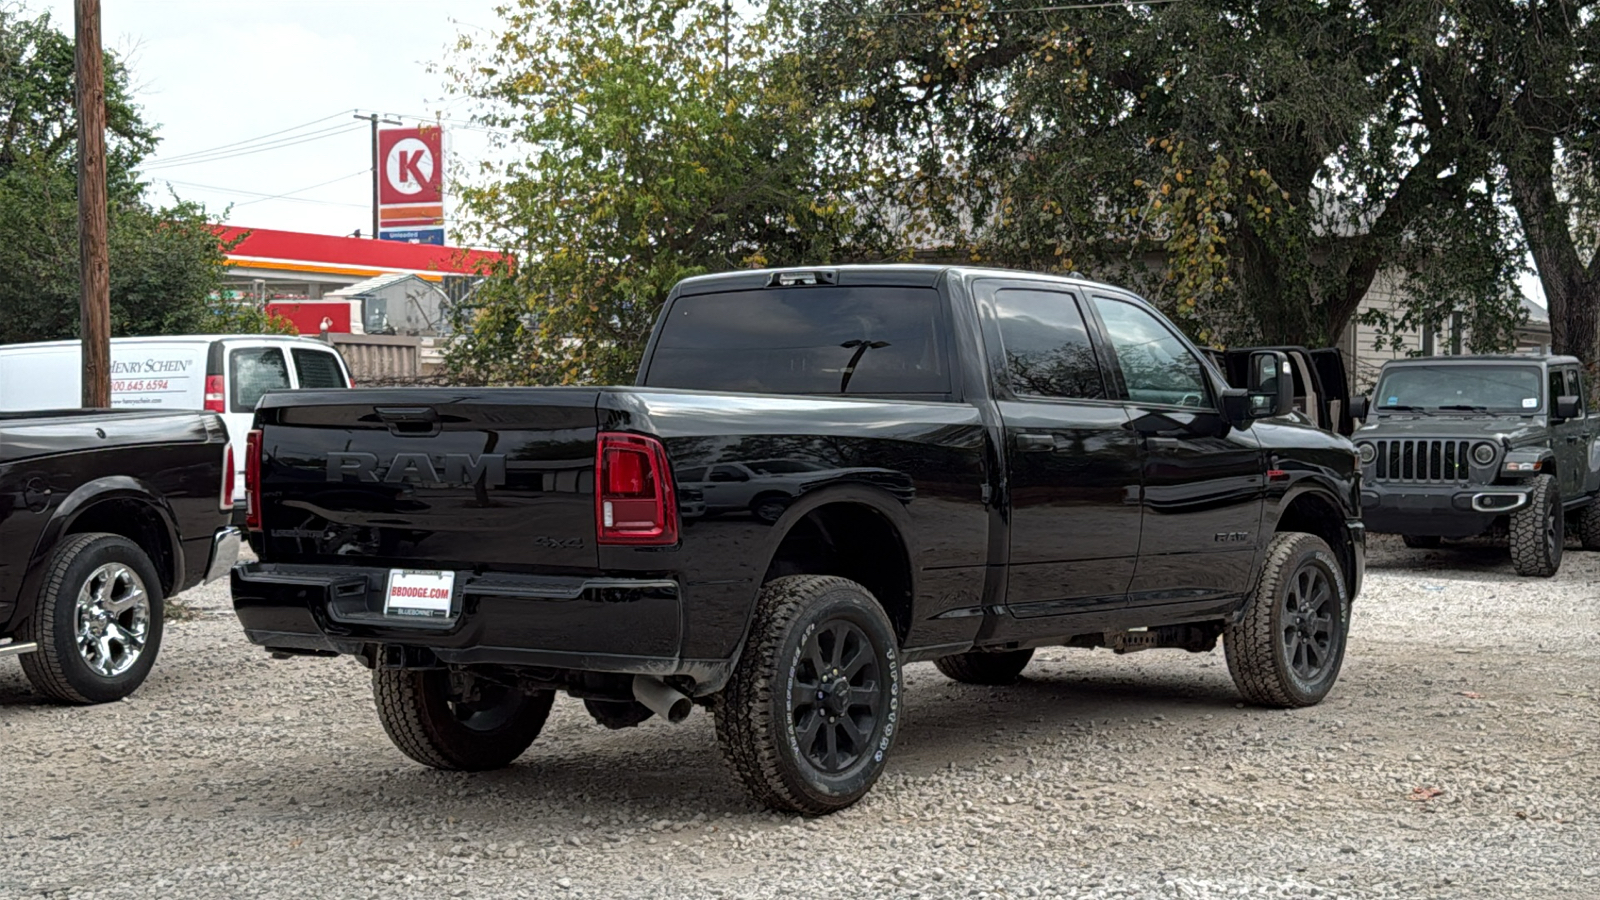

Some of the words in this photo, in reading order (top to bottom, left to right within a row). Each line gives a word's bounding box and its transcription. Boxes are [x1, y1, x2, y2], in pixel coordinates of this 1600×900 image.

[399, 149, 426, 189] K
[326, 452, 506, 486] RAM
[391, 586, 449, 599] BBDODGE.COM
[397, 608, 434, 617] BLUEBONNET
